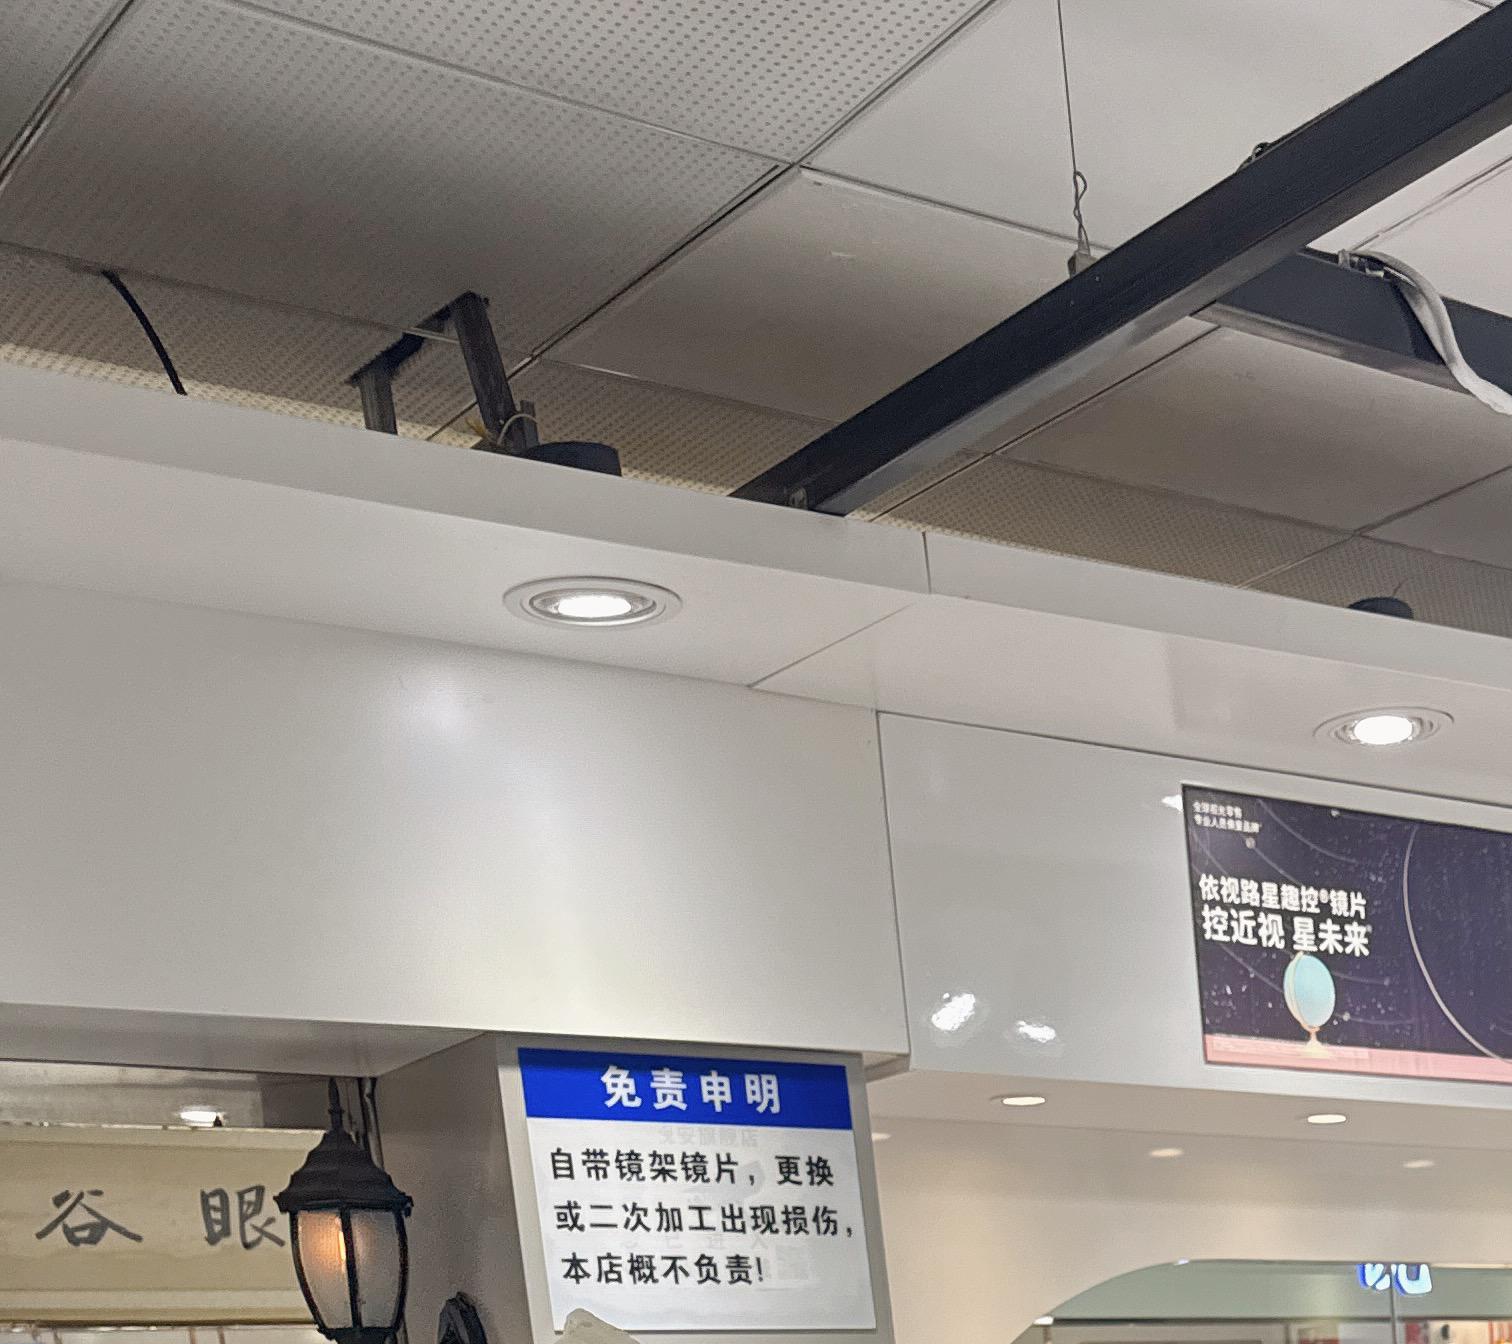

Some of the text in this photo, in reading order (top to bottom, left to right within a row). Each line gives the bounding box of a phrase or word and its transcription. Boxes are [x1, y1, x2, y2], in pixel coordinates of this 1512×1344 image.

[1202, 903, 1370, 957] 控近视 星未来
[601, 1064, 781, 1114] 免责申明
